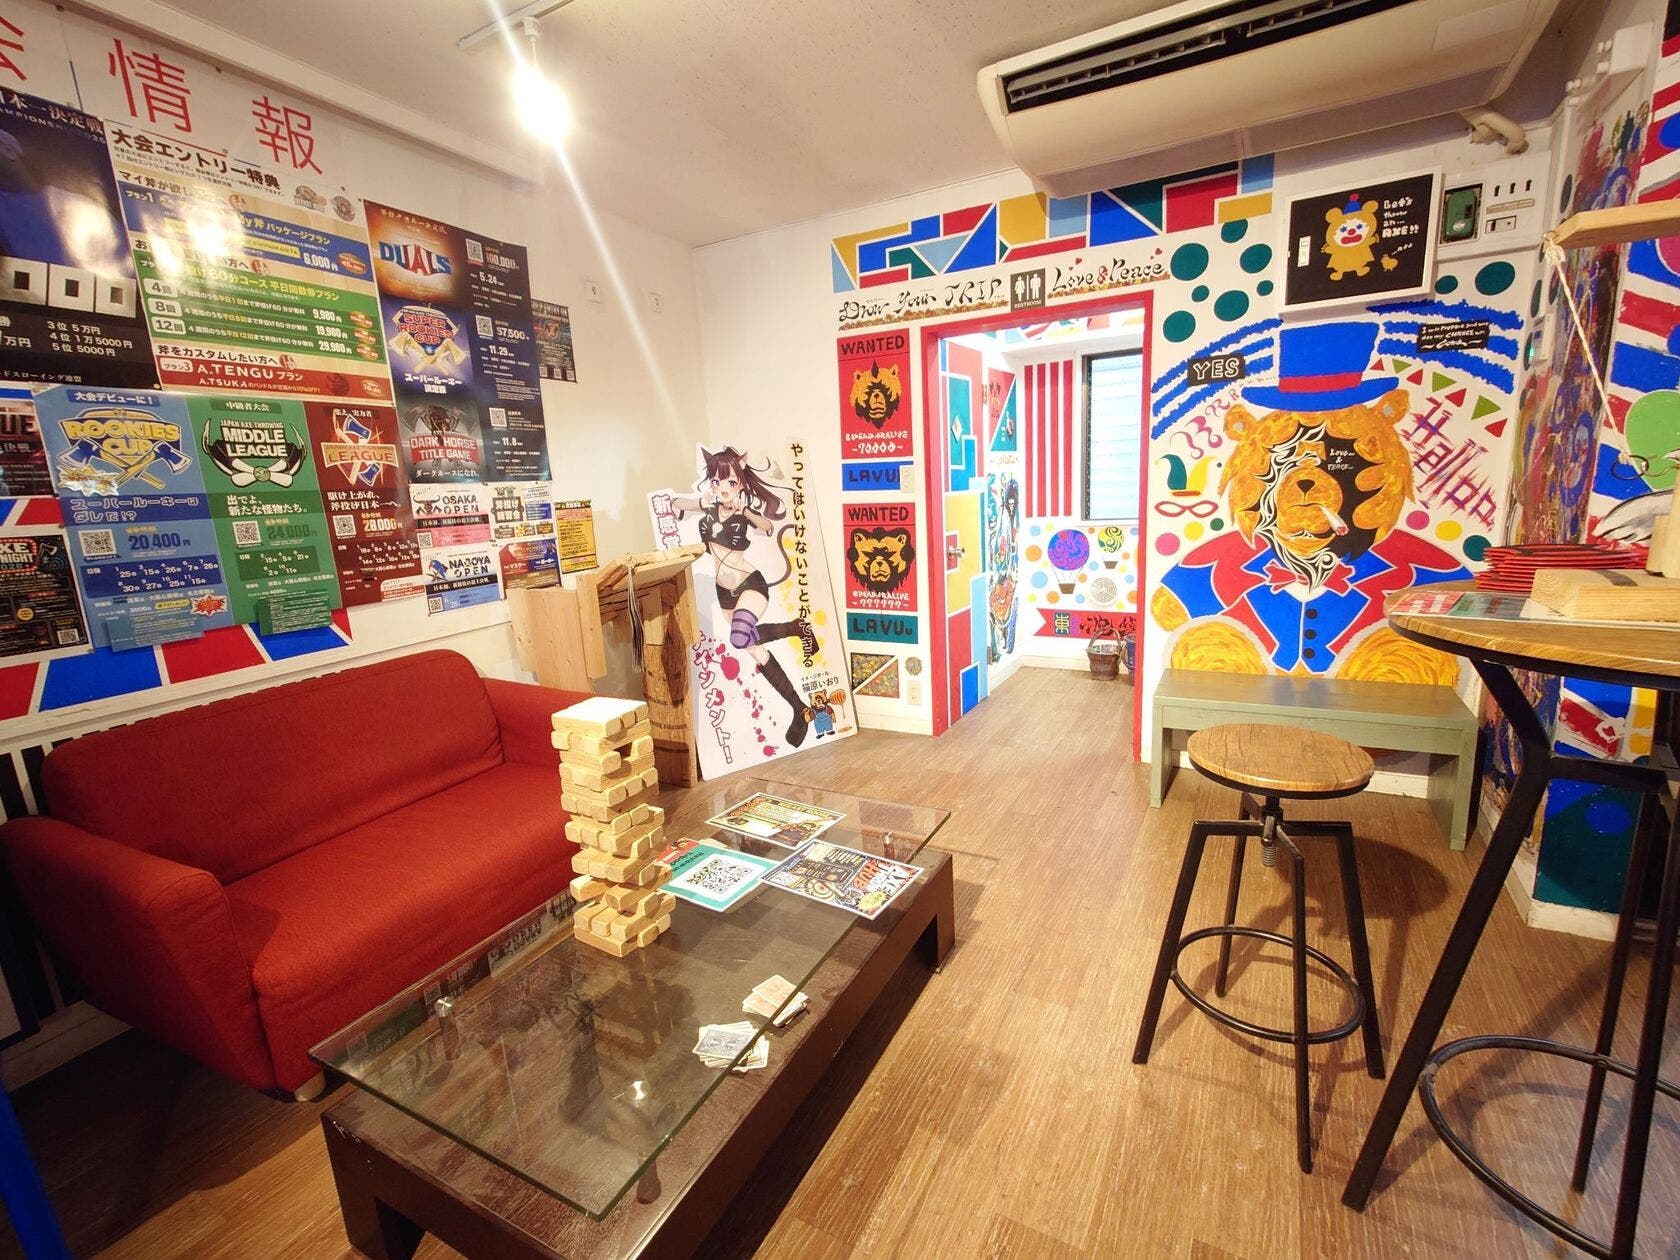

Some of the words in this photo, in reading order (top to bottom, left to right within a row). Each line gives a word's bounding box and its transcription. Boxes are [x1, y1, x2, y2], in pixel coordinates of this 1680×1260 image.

[112, 128, 281, 190] 大会エントリー特典
[1052, 267, 1094, 292] Love
[1097, 265, 1108, 285] &
[1109, 258, 1164, 281] Peace
[151, 281, 172, 294] 4回
[944, 276, 1002, 306] TRIP
[155, 301, 176, 313] 8回
[156, 320, 183, 332] 12回
[403, 313, 446, 327] SUPER
[47, 321, 68, 331] 3位
[72, 324, 101, 335] 5万円
[398, 323, 453, 338] ROOKIES
[50, 332, 71, 342] 4位
[75, 334, 133, 349] 1万5000円
[413, 333, 442, 344] CUP
[841, 335, 905, 355] WANTED
[52, 342, 73, 352] 5位
[77, 345, 116, 356] 5000円
[158, 344, 278, 365] 斧をカスタムしたい方へ
[0, 370, 82, 382] ドスローイング連盟
[197, 364, 274, 379] A.TENGU
[276, 371, 304, 381] プラン
[1193, 358, 1240, 380] YES
[225, 402, 270, 411] 中級者大会
[63, 420, 180, 441] ROOKIES
[221, 427, 285, 443] MIDDLE
[101, 437, 156, 456] CUP
[410, 436, 440, 448] DARK
[443, 437, 477, 449] HORSE
[226, 444, 288, 457] LEAGUE
[328, 451, 394, 463] LEAGUE
[419, 449, 445, 459] TITLE
[442, 494, 477, 504] OSAKA
[228, 504, 307, 516] 新たな怪物たち。
[443, 504, 480, 514] OPEN
[848, 506, 909, 521] WANTED
[448, 556, 491, 569] NAGOYA
[790, 443, 814, 668] やってはいけないことができる
[453, 565, 489, 578] OPEN
